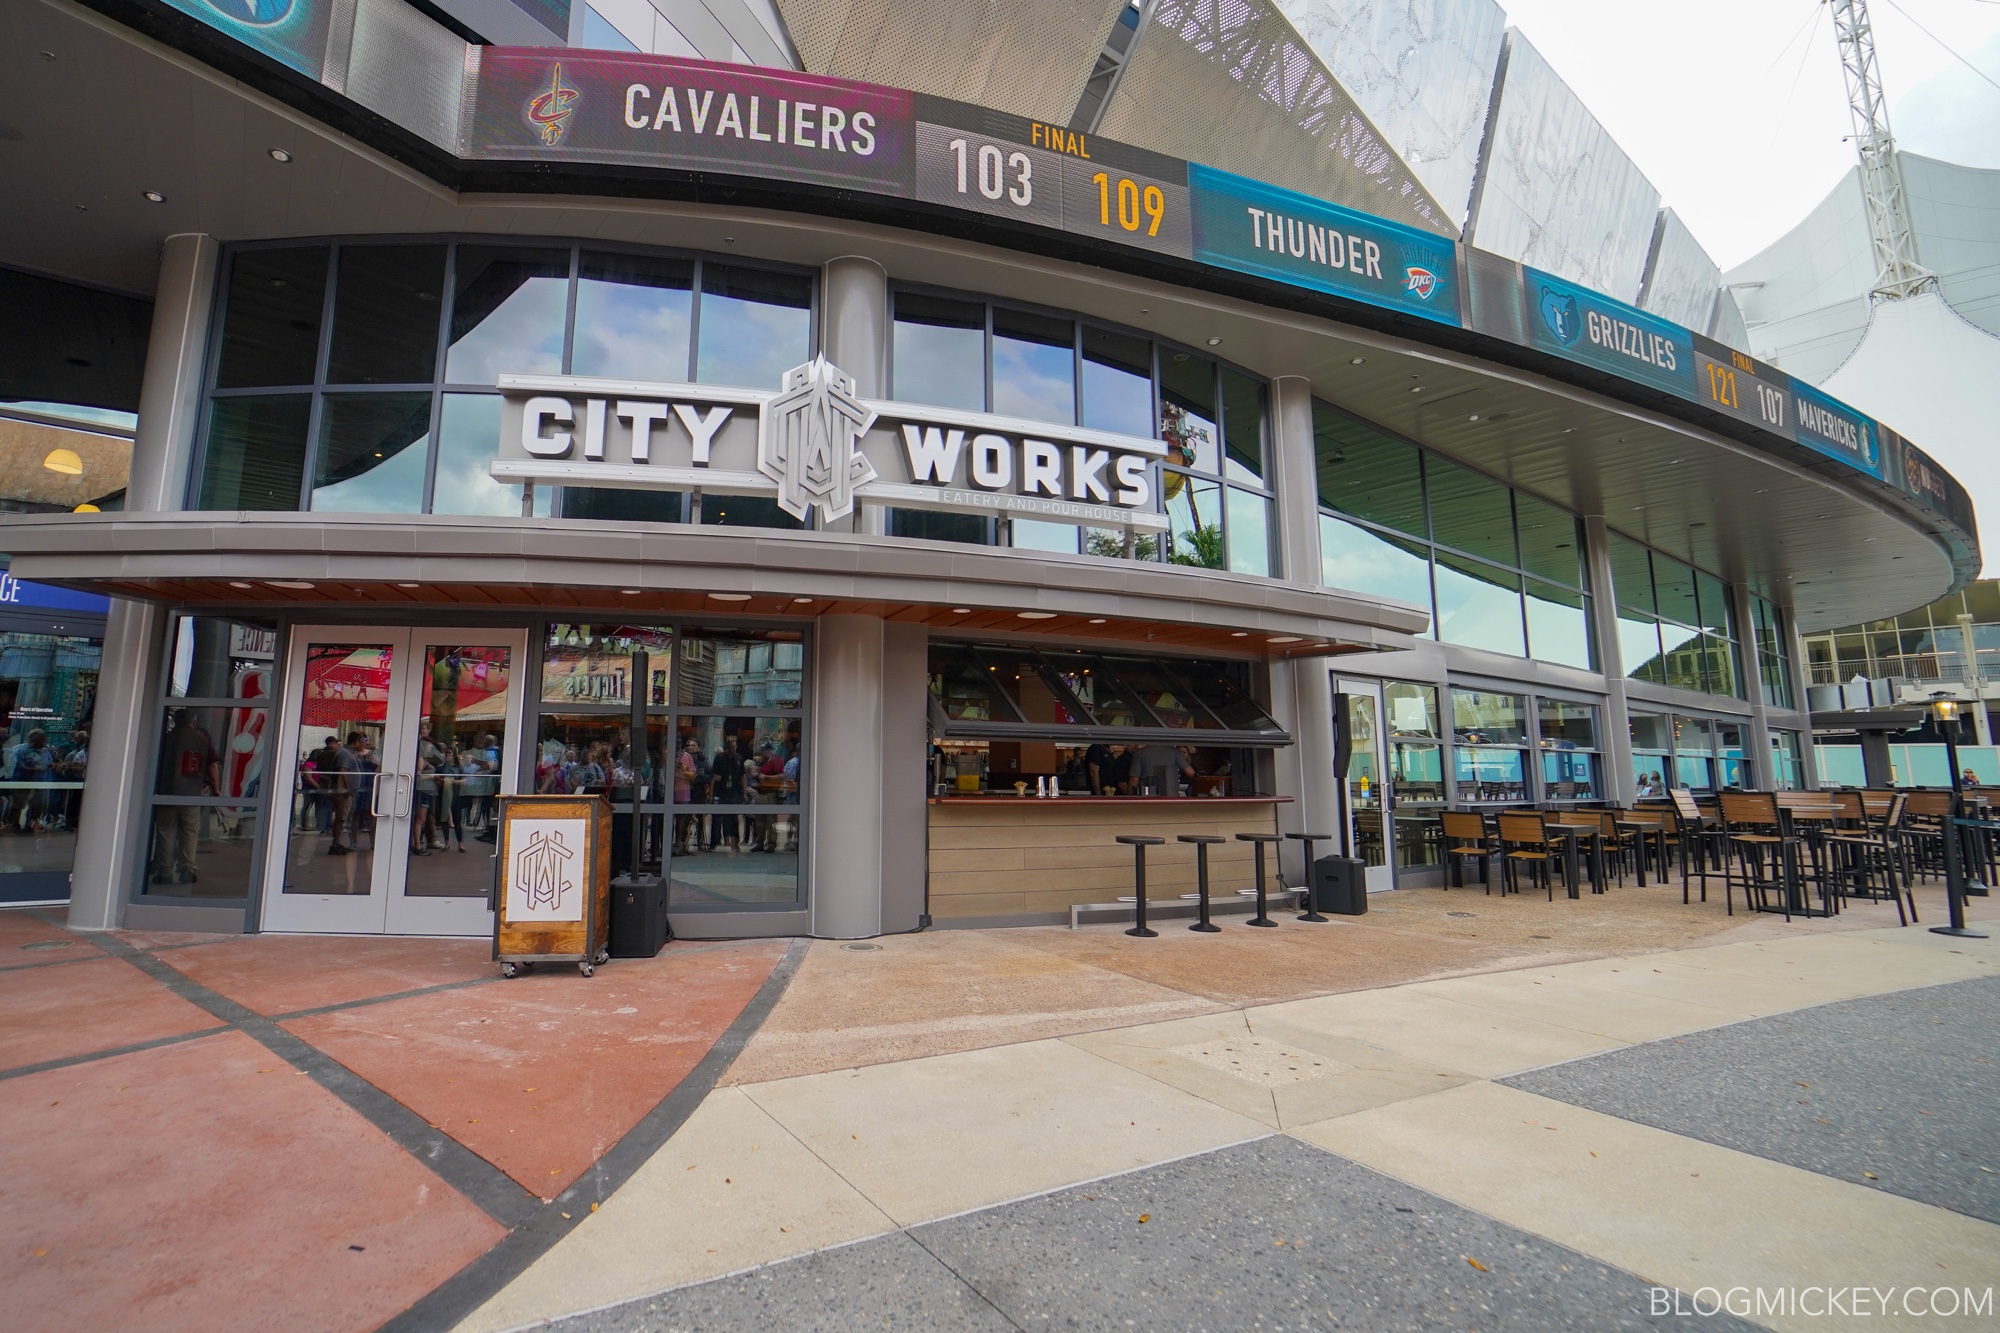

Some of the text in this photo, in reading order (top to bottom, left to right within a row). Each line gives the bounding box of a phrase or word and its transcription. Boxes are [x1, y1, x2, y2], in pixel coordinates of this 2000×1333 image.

[624, 83, 876, 156] CAVALIERS
[1031, 122, 1091, 159] FINAL
[950, 138, 1032, 206] 103
[1092, 172, 1165, 237] 109
[1247, 207, 1383, 280] THUNDER
[1408, 274, 1431, 290] OKC
[1587, 310, 1677, 371] GRIZZLIES
[1731, 351, 1756, 375] FINAL
[1706, 363, 1739, 409] 121
[1756, 384, 1784, 427] 107
[1797, 398, 1858, 450] MAVERICKS
[521, 396, 1150, 507] CITY WORKS
[942, 490, 1128, 523] EATERY AND POUR HOUSE
[0, 573, 21, 602] CE
